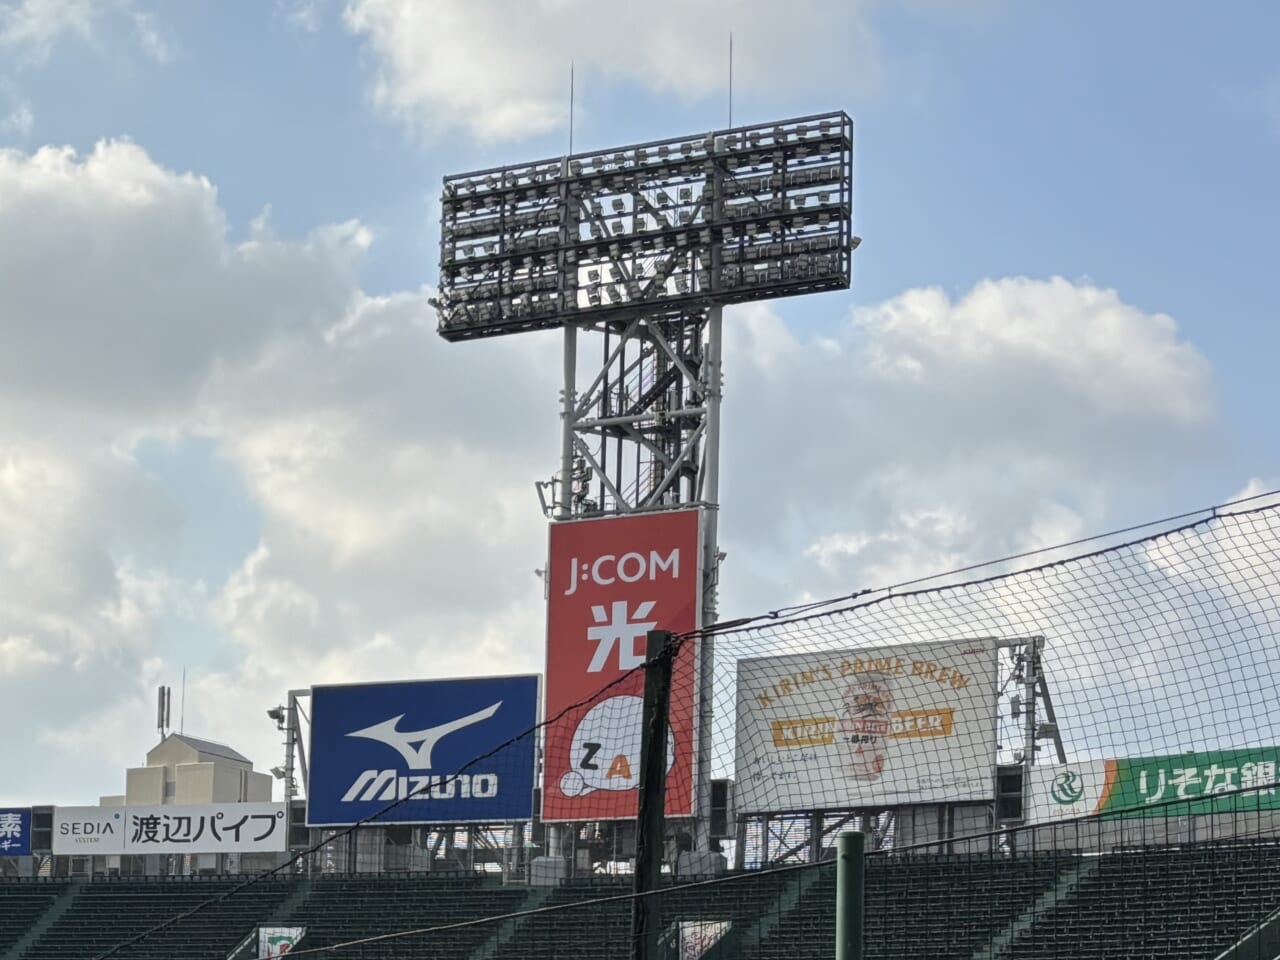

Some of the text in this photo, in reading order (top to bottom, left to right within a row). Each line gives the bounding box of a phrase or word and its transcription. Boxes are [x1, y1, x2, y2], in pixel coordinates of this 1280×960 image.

[564, 549, 680, 596] J:COM
[586, 601, 658, 672] 光
[840, 656, 905, 678] PRIME
[912, 659, 971, 690] BREW
[1139, 761, 1280, 804] りそな銀
[131, 811, 285, 844] 渡辺パイプ
